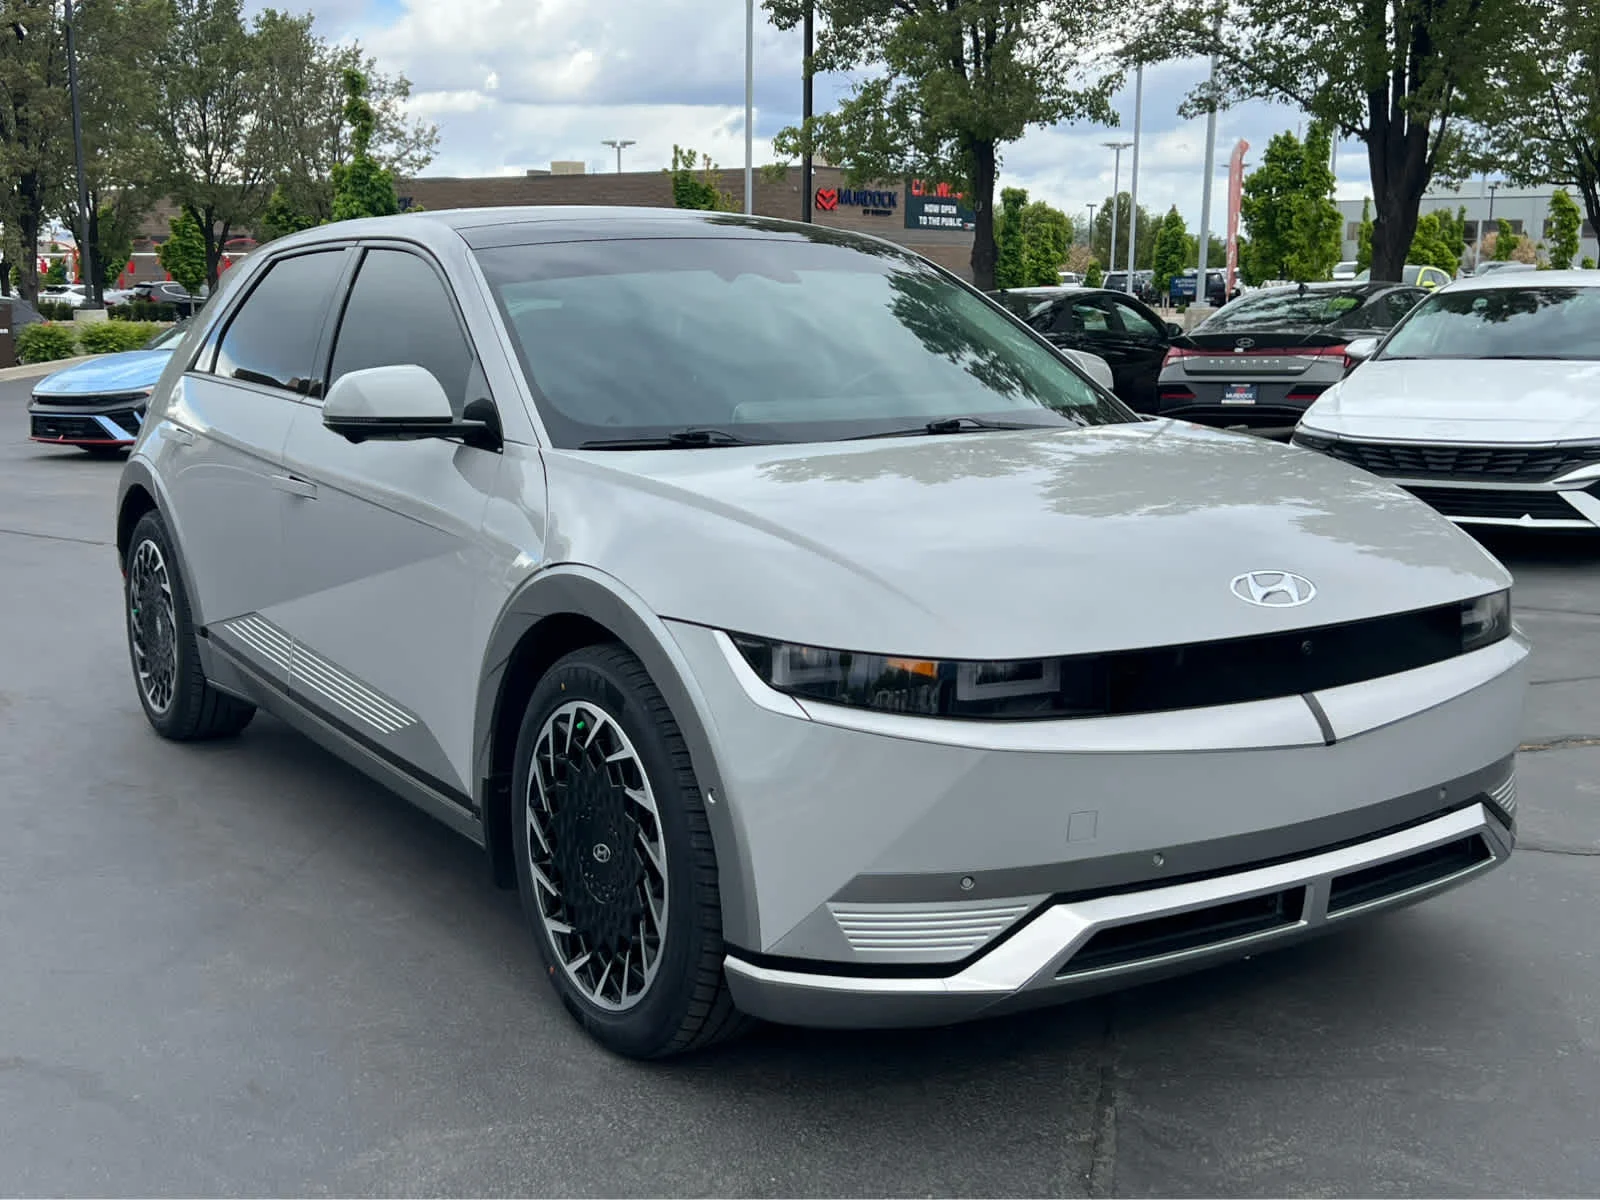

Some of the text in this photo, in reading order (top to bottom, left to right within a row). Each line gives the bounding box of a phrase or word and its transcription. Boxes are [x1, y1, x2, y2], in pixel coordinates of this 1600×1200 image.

[838, 188, 897, 208] MURDOCK
[924, 203, 957, 214] NOW OPEN
[918, 216, 928, 225] TO
[928, 216, 941, 226] THE
[941, 217, 963, 227] PUBLIC
